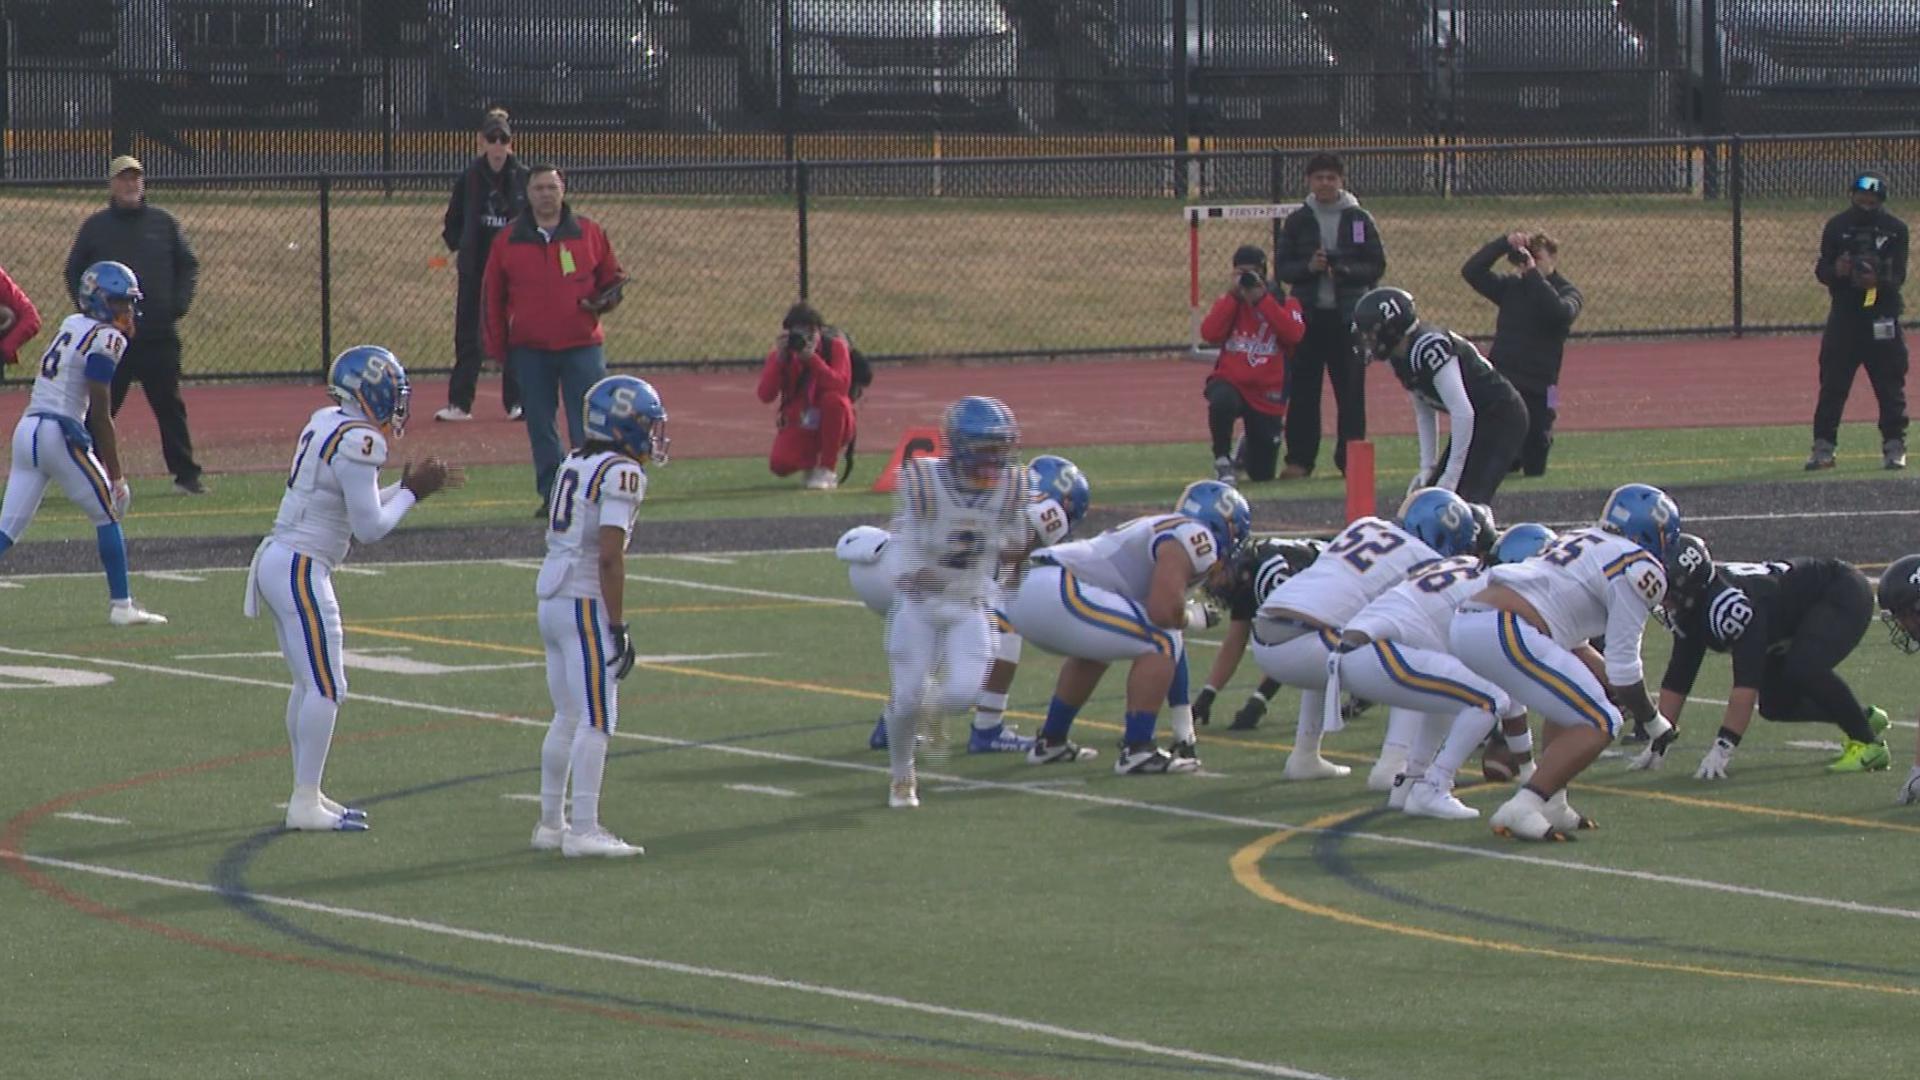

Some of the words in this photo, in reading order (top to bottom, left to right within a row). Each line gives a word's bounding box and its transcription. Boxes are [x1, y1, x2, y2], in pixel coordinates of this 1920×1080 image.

[1379, 298, 1402, 320] 21
[105, 333, 125, 355] 16
[1423, 342, 1451, 371] 21
[361, 355, 386, 385] S
[610, 387, 638, 418] S
[361, 435, 374, 456] 3
[619, 470, 641, 493] 10
[1053, 465, 1083, 493] S
[552, 467, 580, 533] 0
[1214, 487, 1241, 518] S
[1650, 497, 1672, 524] S
[1040, 506, 1063, 534] 58
[1440, 501, 1461, 529] S
[938, 529, 987, 570] 2
[1189, 531, 1213, 558] 50
[1327, 522, 1406, 572] 52
[1678, 547, 1703, 575] 99
[1637, 570, 1663, 600] 55
[1721, 602, 1754, 641] 99
